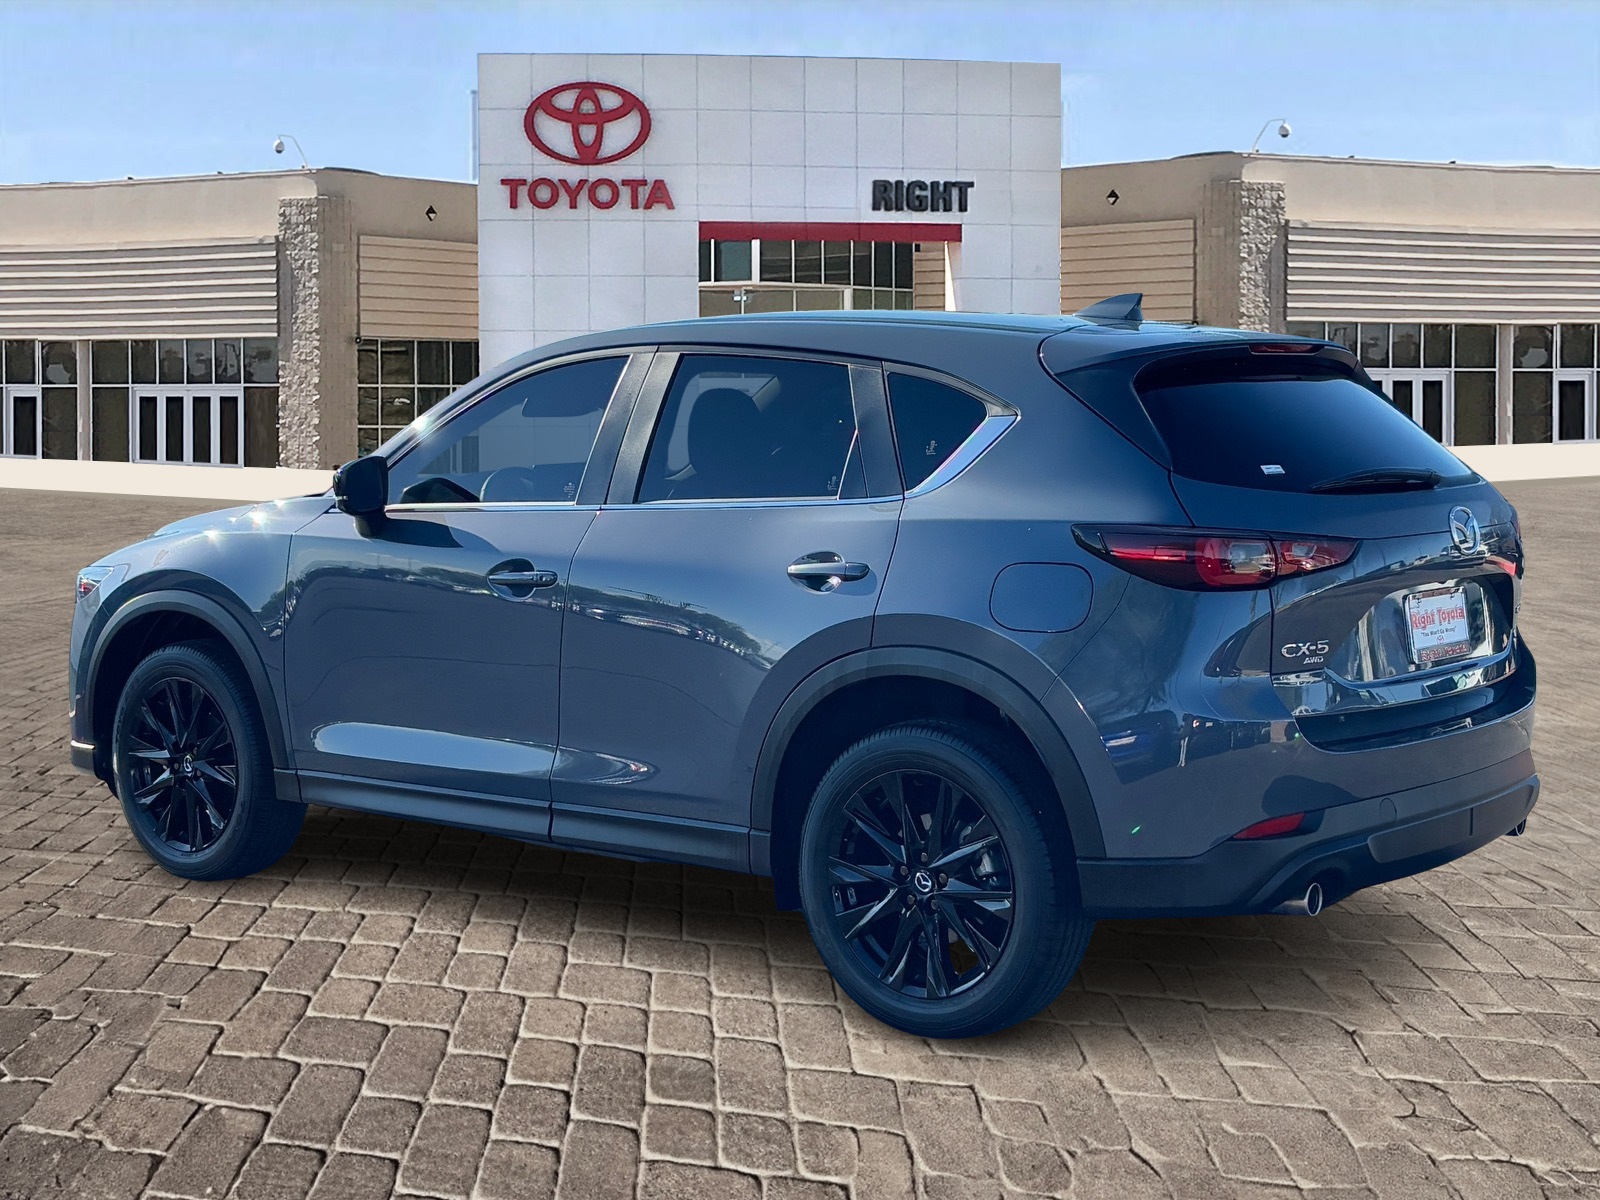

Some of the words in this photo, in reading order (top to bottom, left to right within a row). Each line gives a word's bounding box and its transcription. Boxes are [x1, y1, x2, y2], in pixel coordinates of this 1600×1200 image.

[500, 178, 675, 210] TOYOTA
[871, 179, 975, 213] RIGHT
[1411, 609, 1436, 630] Right
[1437, 606, 1465, 626] Toyota
[1281, 640, 1329, 658] CX-5
[1303, 656, 1324, 664] AWD
